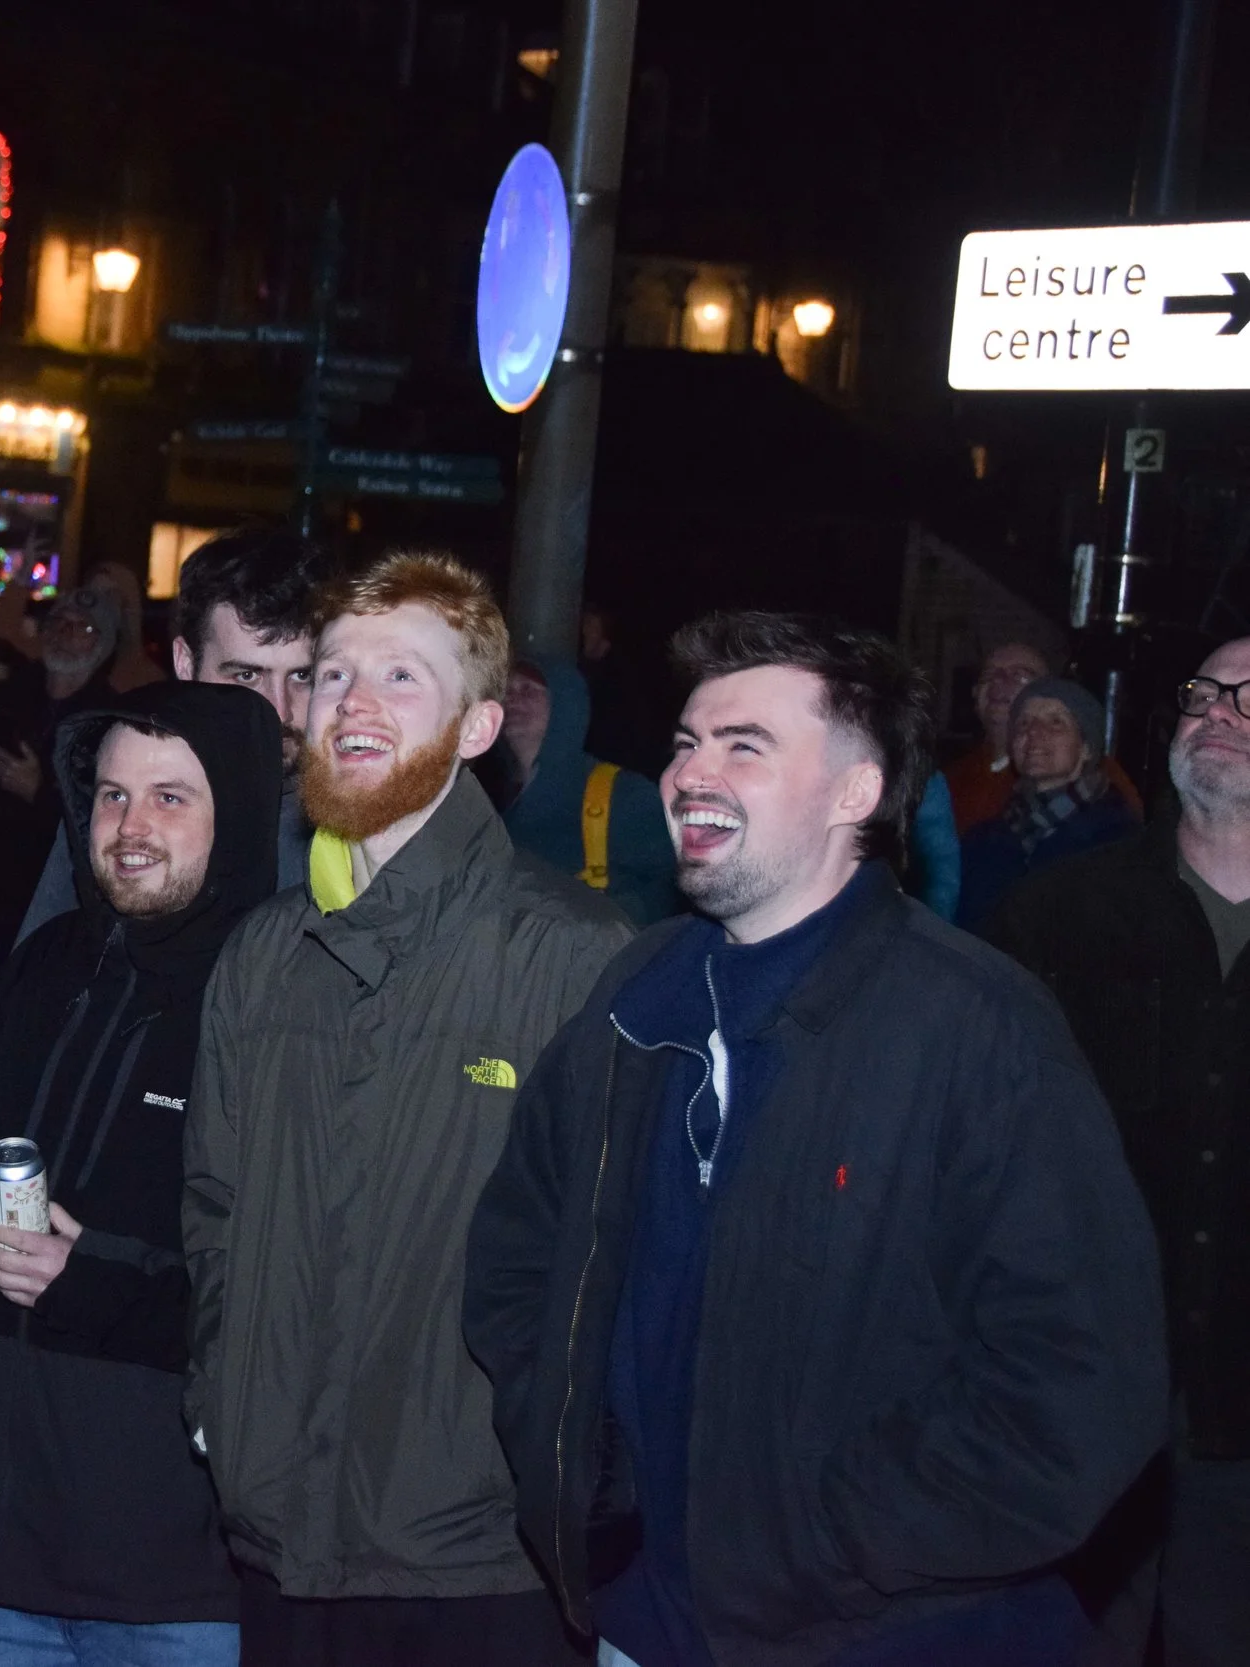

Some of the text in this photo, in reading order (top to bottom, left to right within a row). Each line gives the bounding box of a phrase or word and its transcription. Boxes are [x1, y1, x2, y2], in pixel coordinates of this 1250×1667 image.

[980, 255, 1146, 297] Leisure
[982, 318, 1130, 360] centre
[1133, 435, 1160, 468] 2
[478, 1057, 499, 1068] THE
[463, 1064, 497, 1078] NORTH
[471, 1074, 497, 1086] FACE
[144, 1091, 172, 1103] REGATTA
